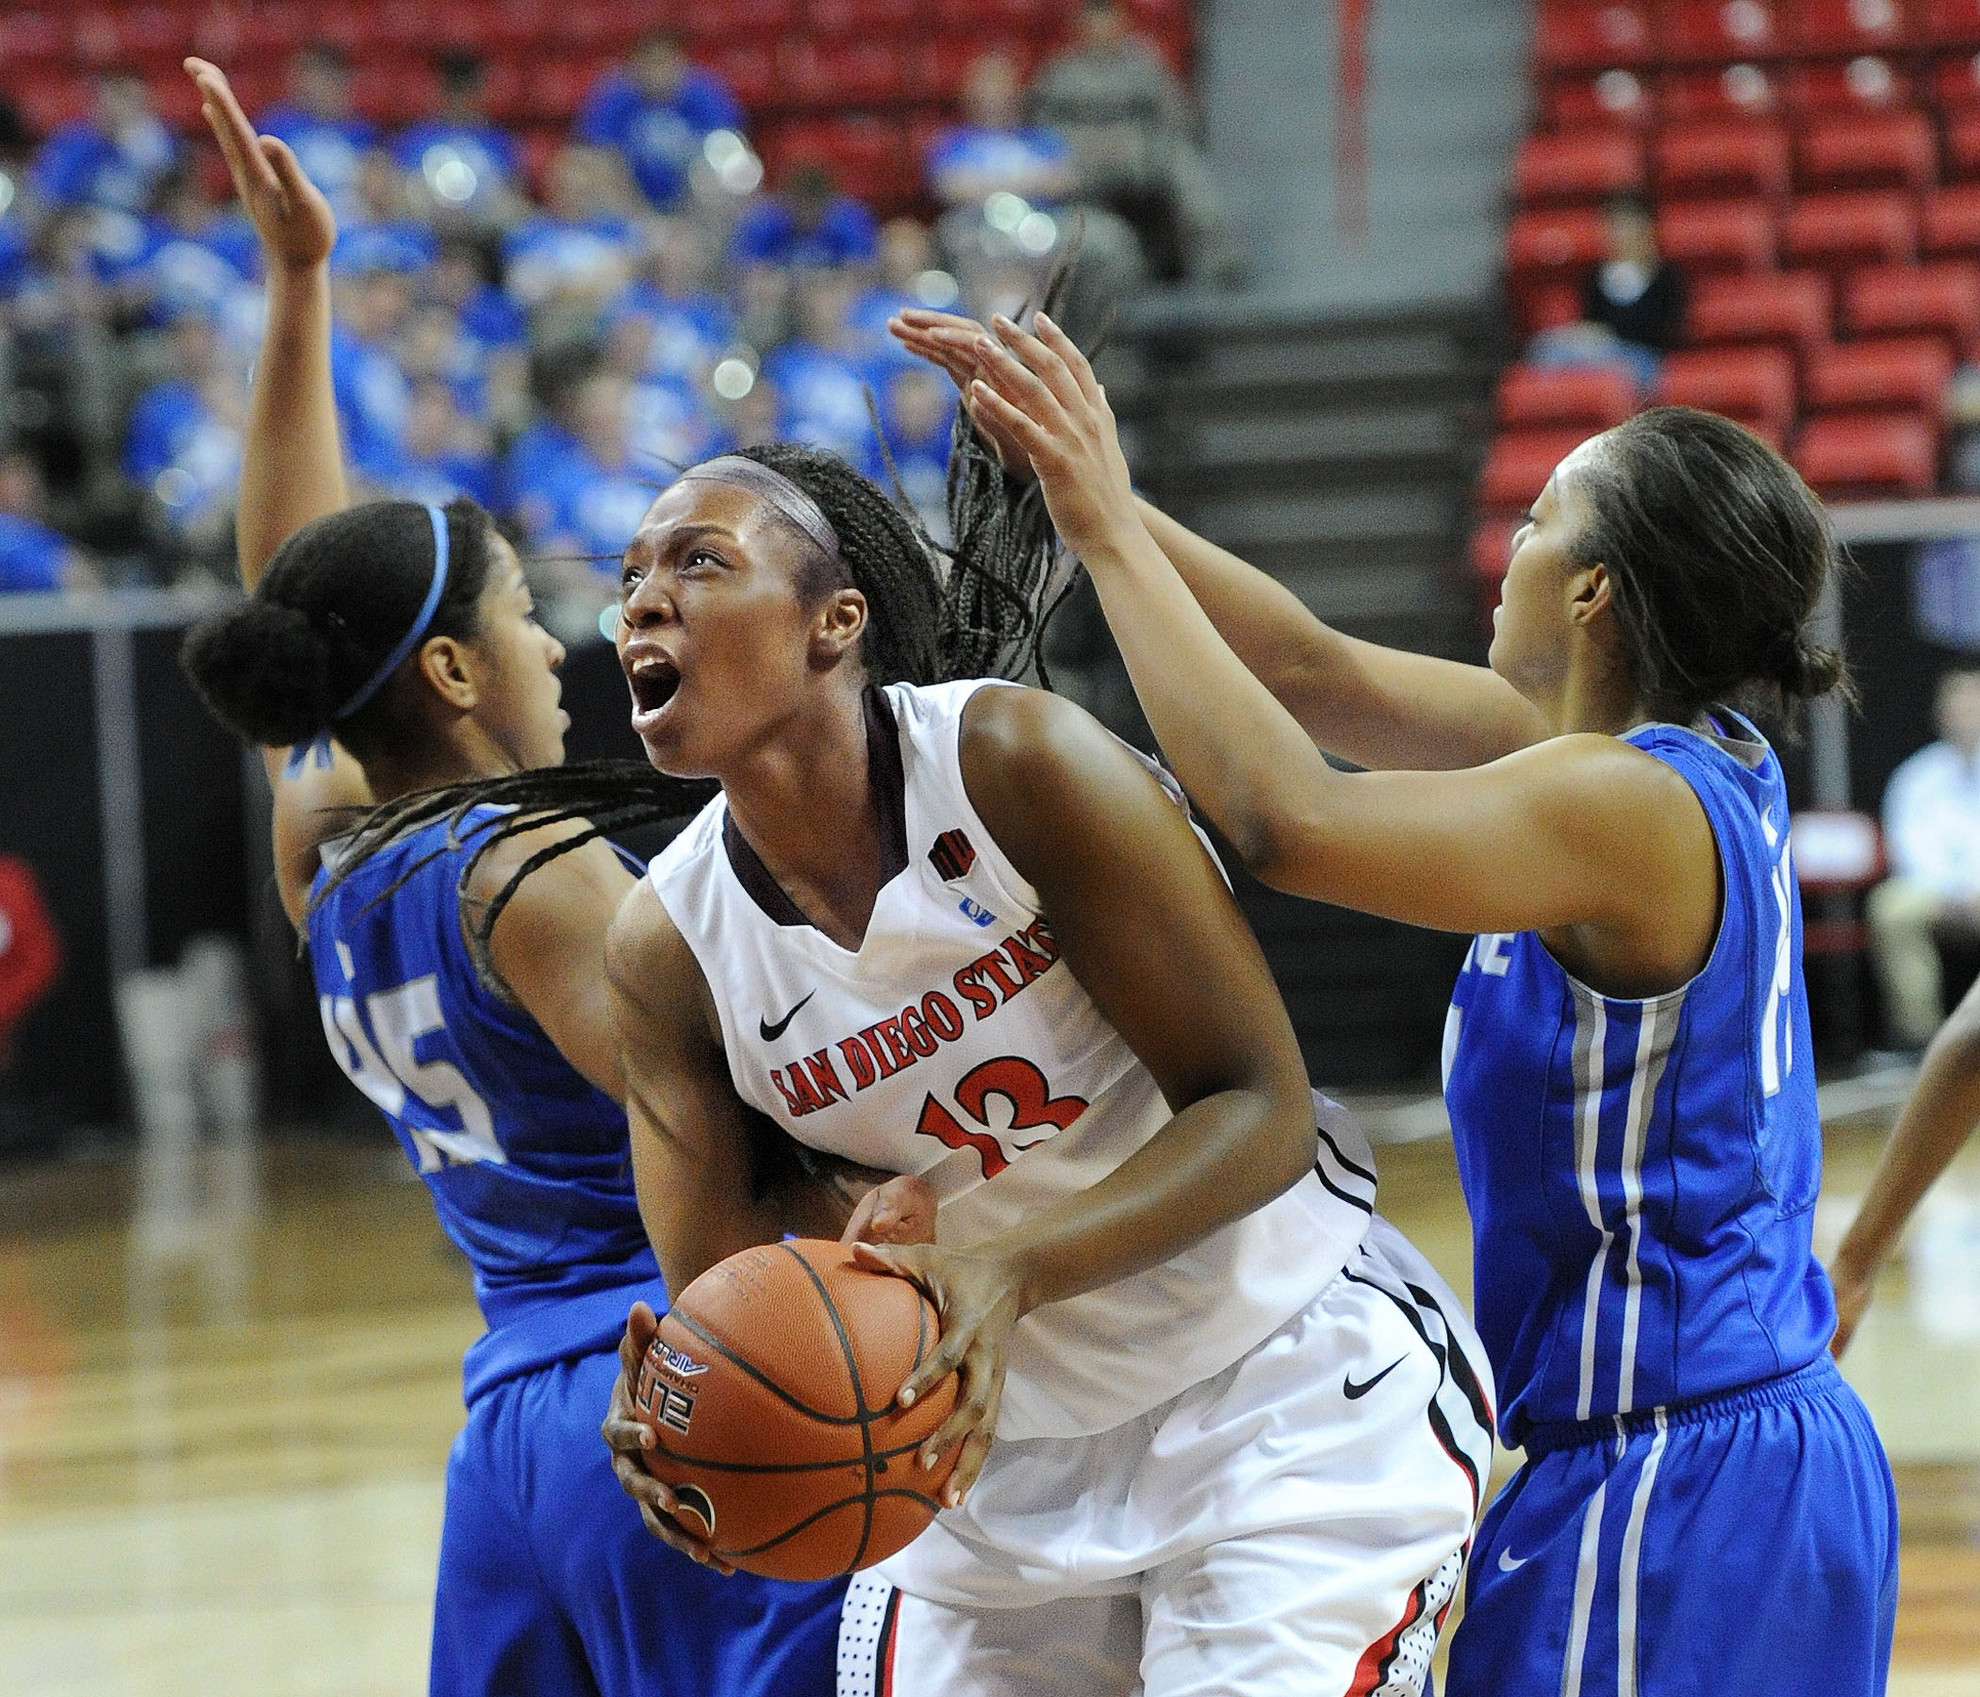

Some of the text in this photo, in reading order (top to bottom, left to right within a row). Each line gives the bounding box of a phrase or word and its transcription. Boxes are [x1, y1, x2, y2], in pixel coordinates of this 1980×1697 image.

[770, 915, 1060, 1117] SAN DIEGO STAT
[915, 1055, 1090, 1181] 13
